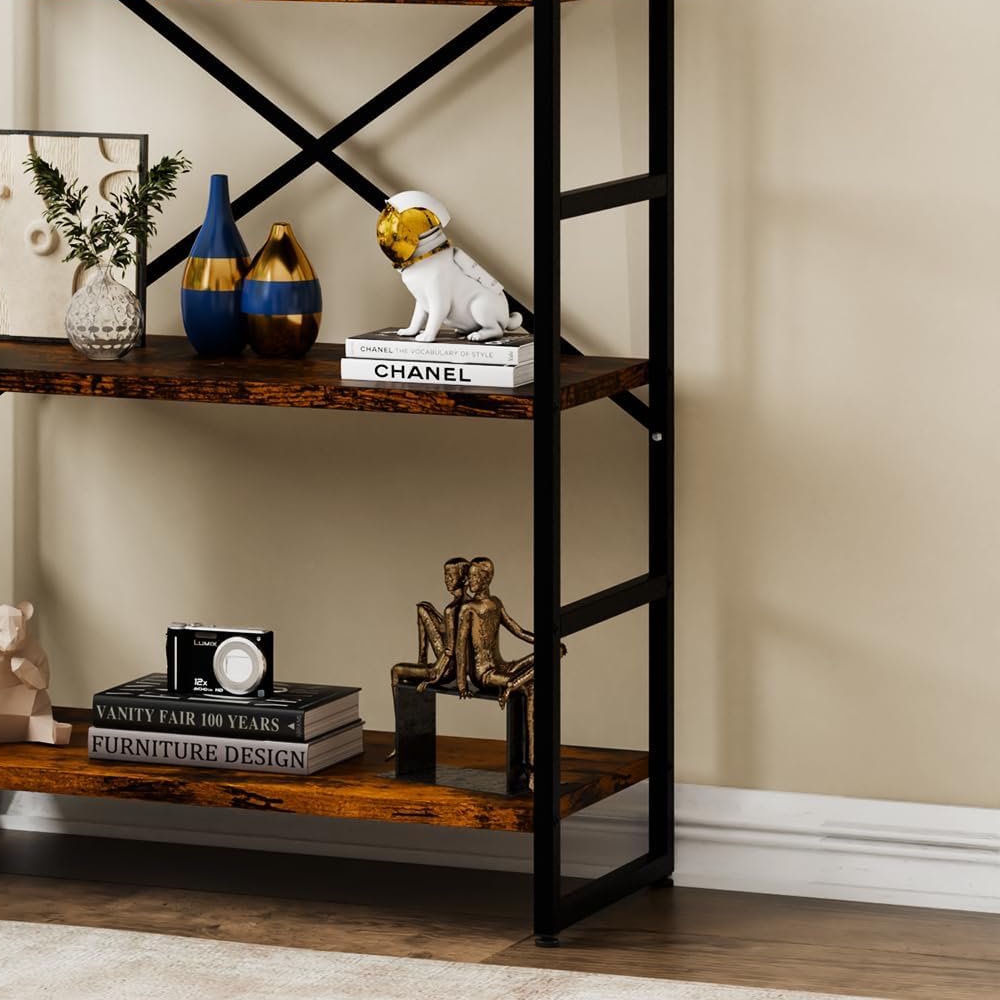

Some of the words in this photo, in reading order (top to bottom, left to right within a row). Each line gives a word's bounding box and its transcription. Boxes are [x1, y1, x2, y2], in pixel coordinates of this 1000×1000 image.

[360, 345, 393, 354] CHANEL
[411, 348, 458, 357] VOCABULARY
[374, 364, 471, 383] CHANEL
[96, 704, 155, 723] VANITY
[159, 709, 196, 726] FAIR
[202, 712, 223, 727] 100
[227, 714, 280, 732] YEARS
[92, 735, 218, 762] FURNITURE
[225, 745, 305, 769] DESIGN
